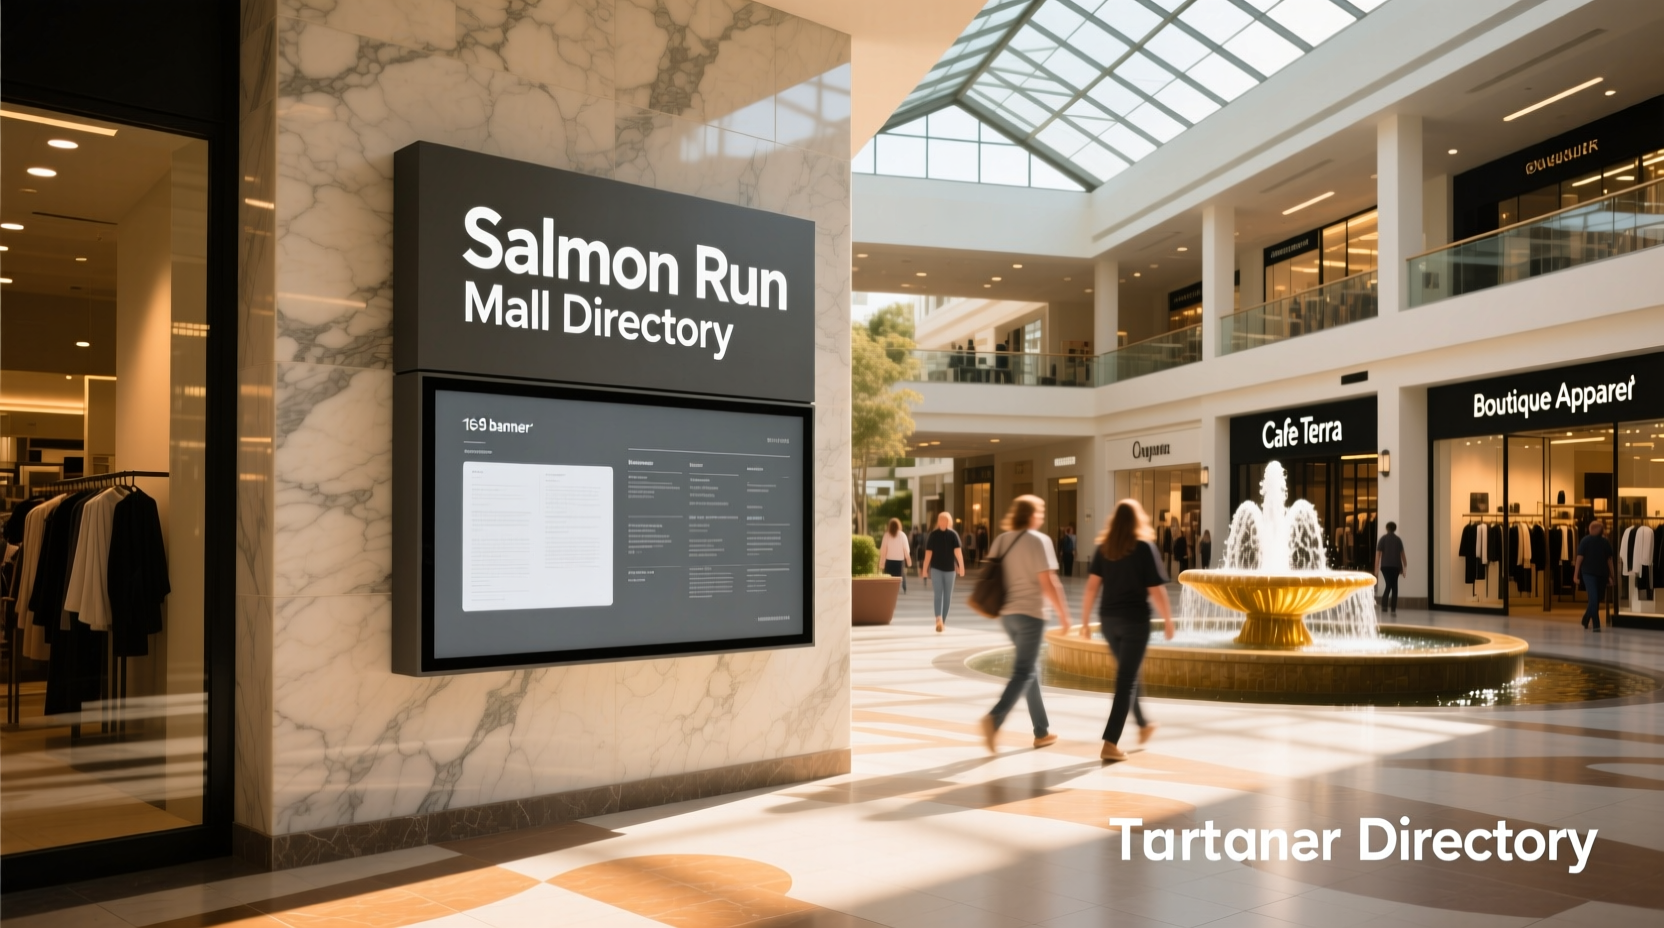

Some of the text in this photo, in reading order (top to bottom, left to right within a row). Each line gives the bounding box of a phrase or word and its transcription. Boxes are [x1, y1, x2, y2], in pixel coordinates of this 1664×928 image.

[462, 206, 788, 310] Salmon Run
[465, 281, 734, 361] Mall Directory
[1262, 415, 1343, 449] Cafe Terra
[1473, 388, 1552, 419] Boutique
